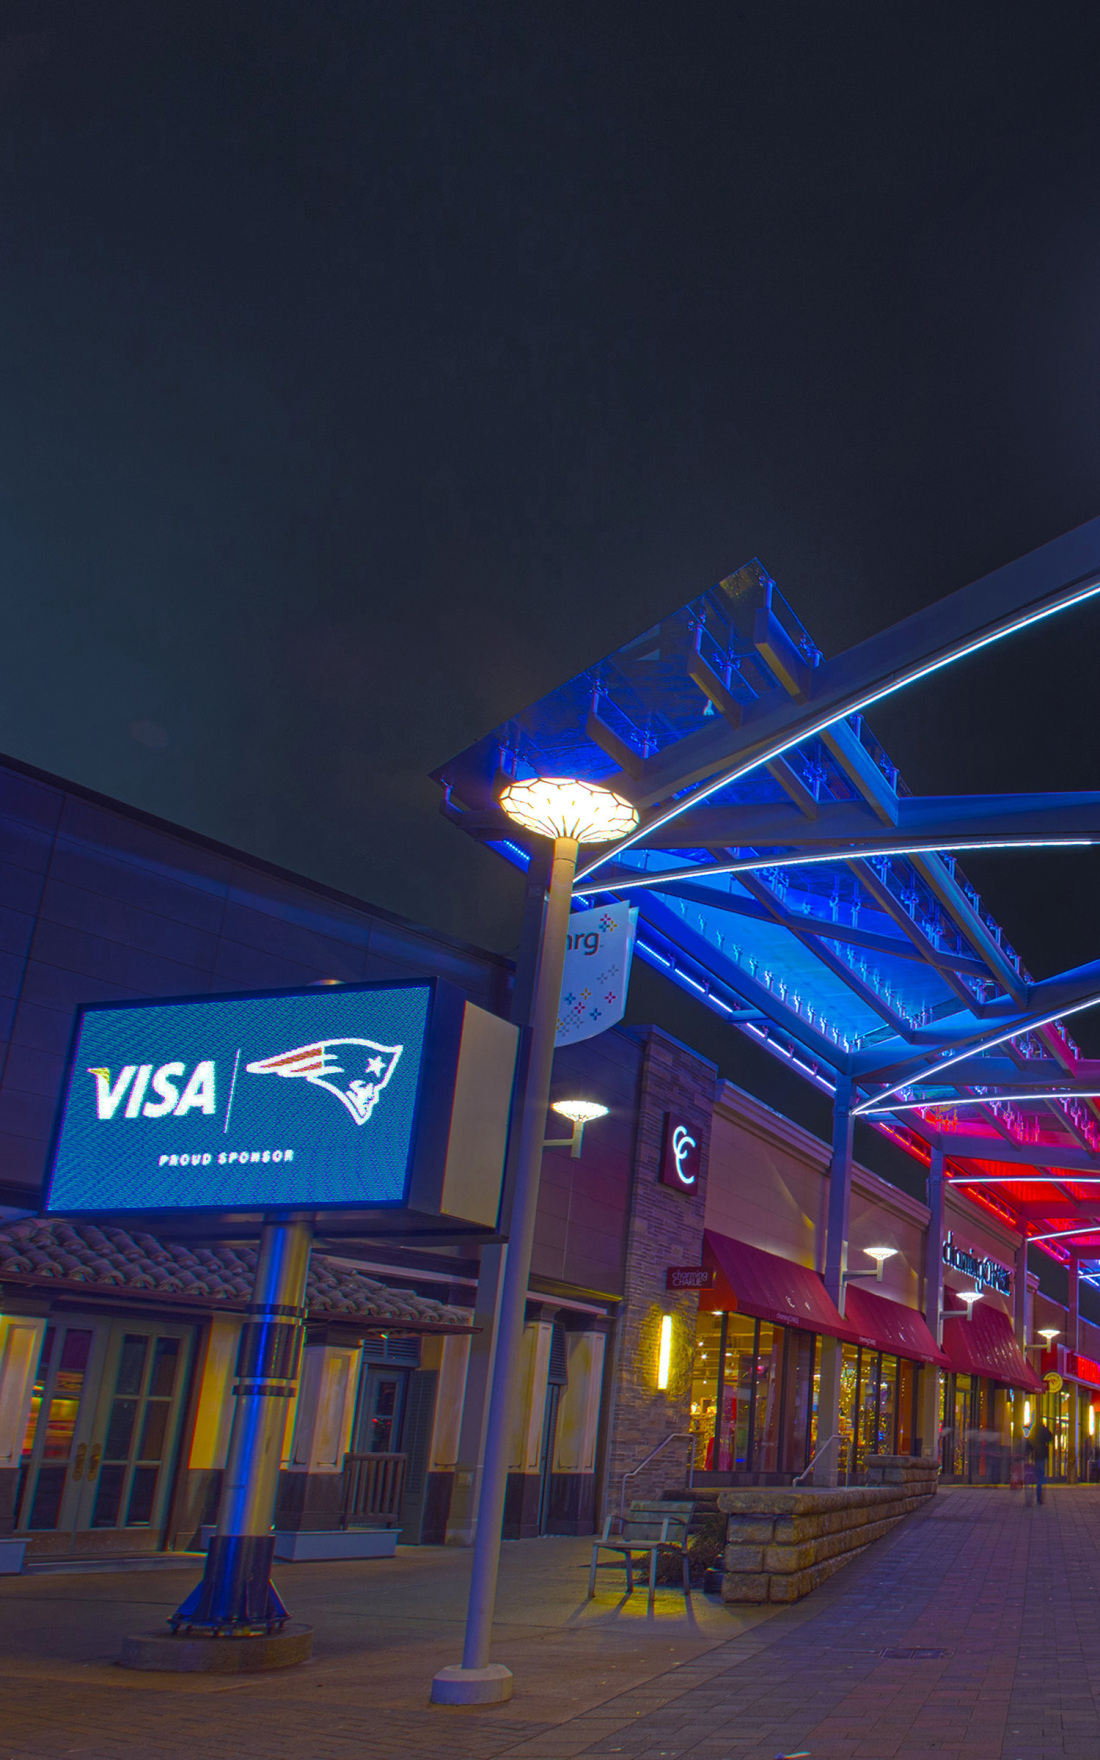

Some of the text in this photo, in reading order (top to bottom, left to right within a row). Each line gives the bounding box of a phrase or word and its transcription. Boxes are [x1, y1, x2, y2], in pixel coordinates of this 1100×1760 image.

[87, 1060, 216, 1120] VISA
[158, 1149, 294, 1167] PROUD SPONSOR
[672, 1270, 708, 1281] charming
[673, 1278, 702, 1287] CHARLIE
